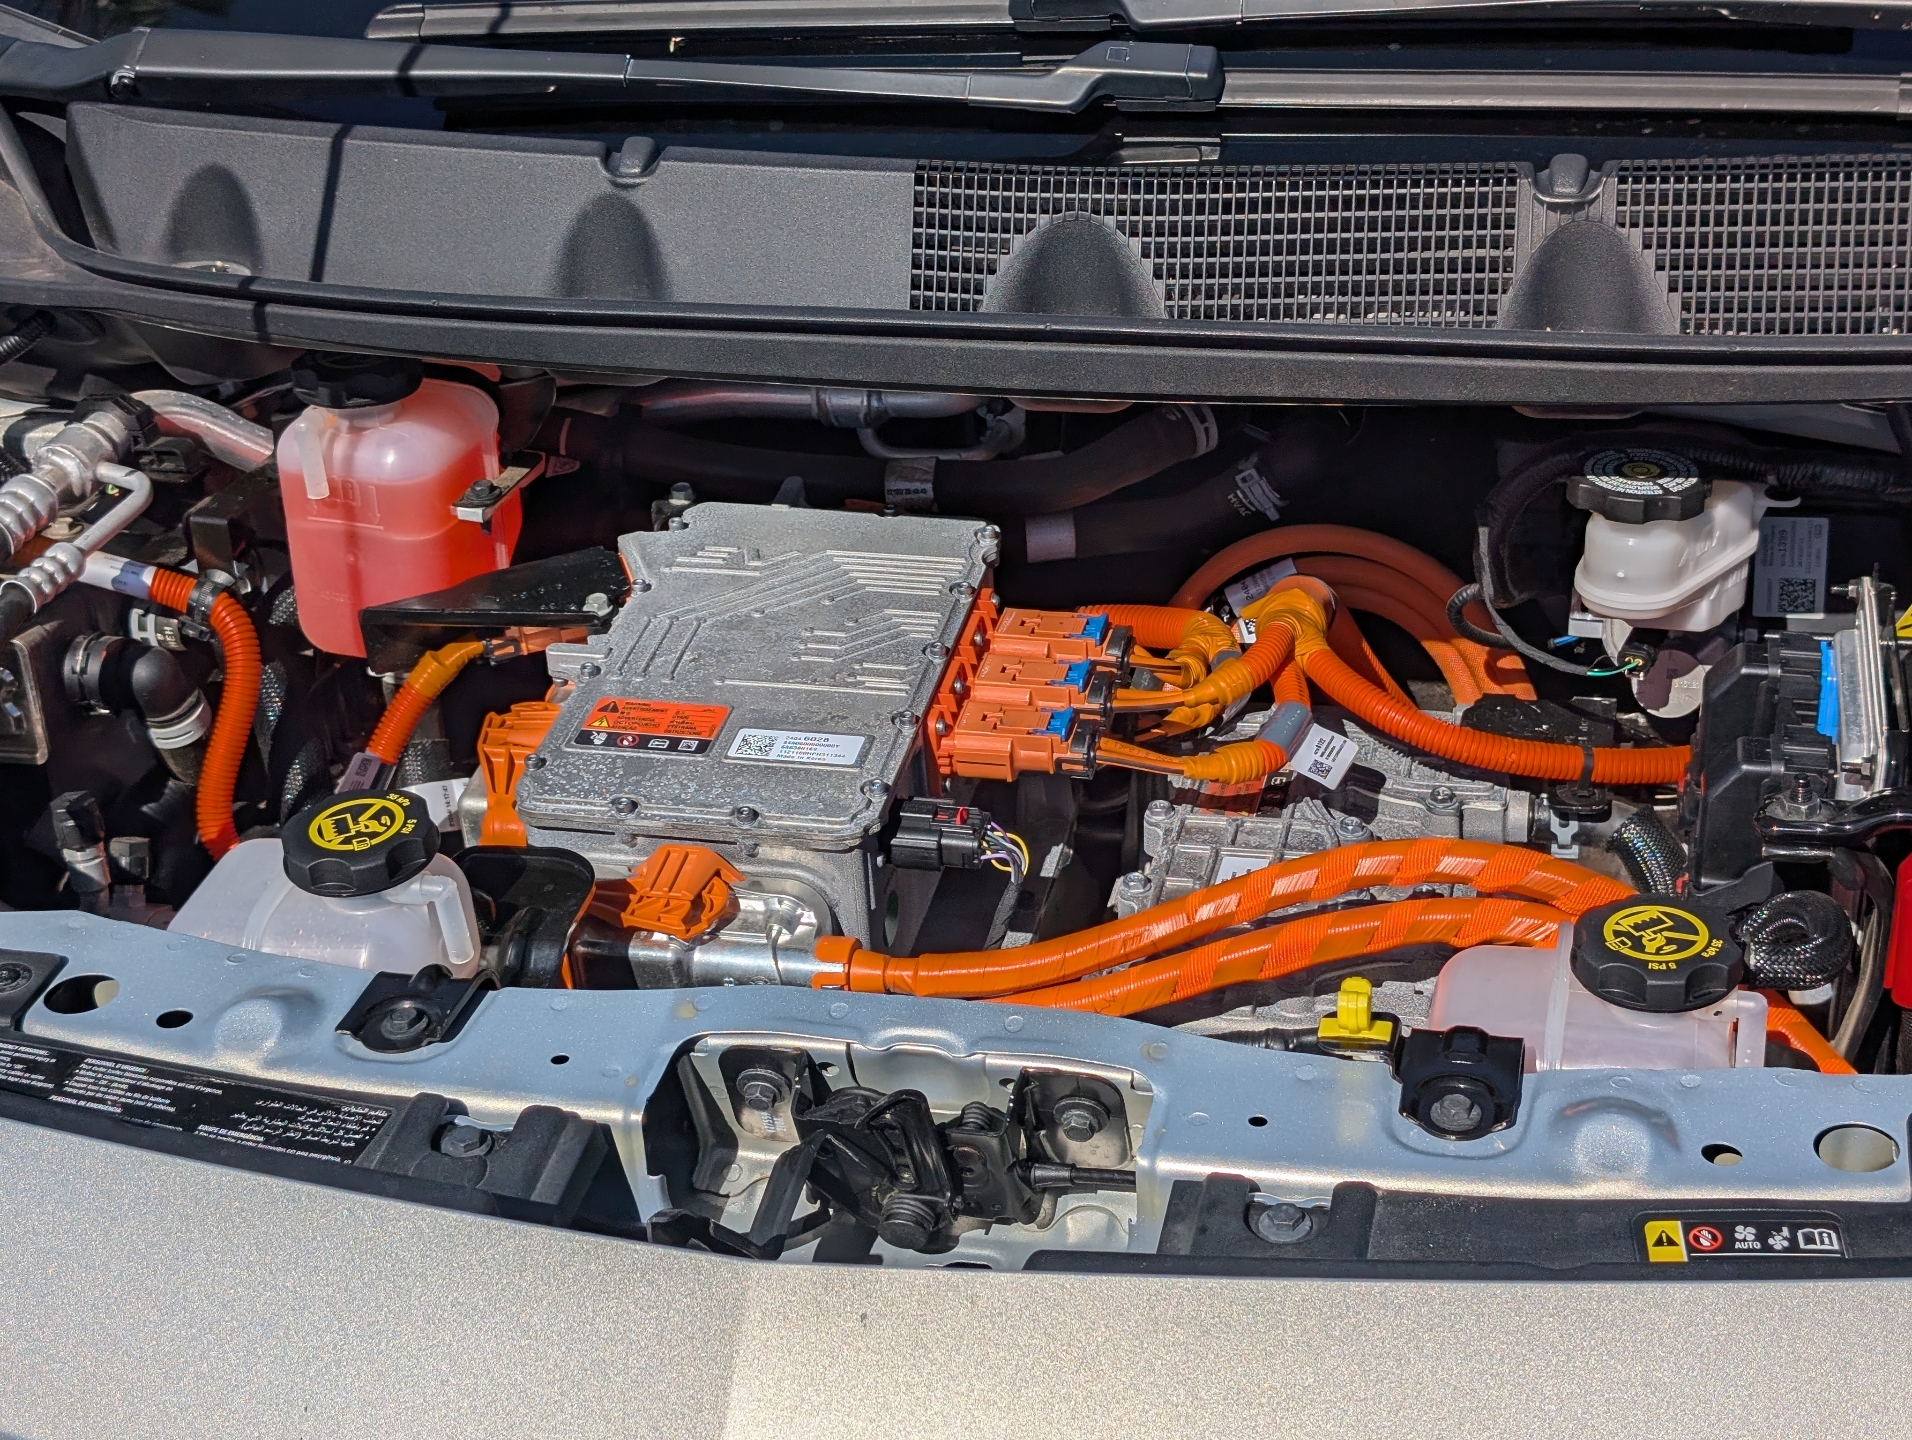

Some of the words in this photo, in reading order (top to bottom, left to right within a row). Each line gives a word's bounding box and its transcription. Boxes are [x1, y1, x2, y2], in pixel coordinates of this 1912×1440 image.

[396, 797, 410, 806] kPa
[401, 824, 415, 834] PSI
[1711, 939, 1723, 947] 35
[1701, 946, 1720, 957] kPa
[1648, 962, 1667, 970] PSI
[1734, 1241, 1761, 1249] AUTO
